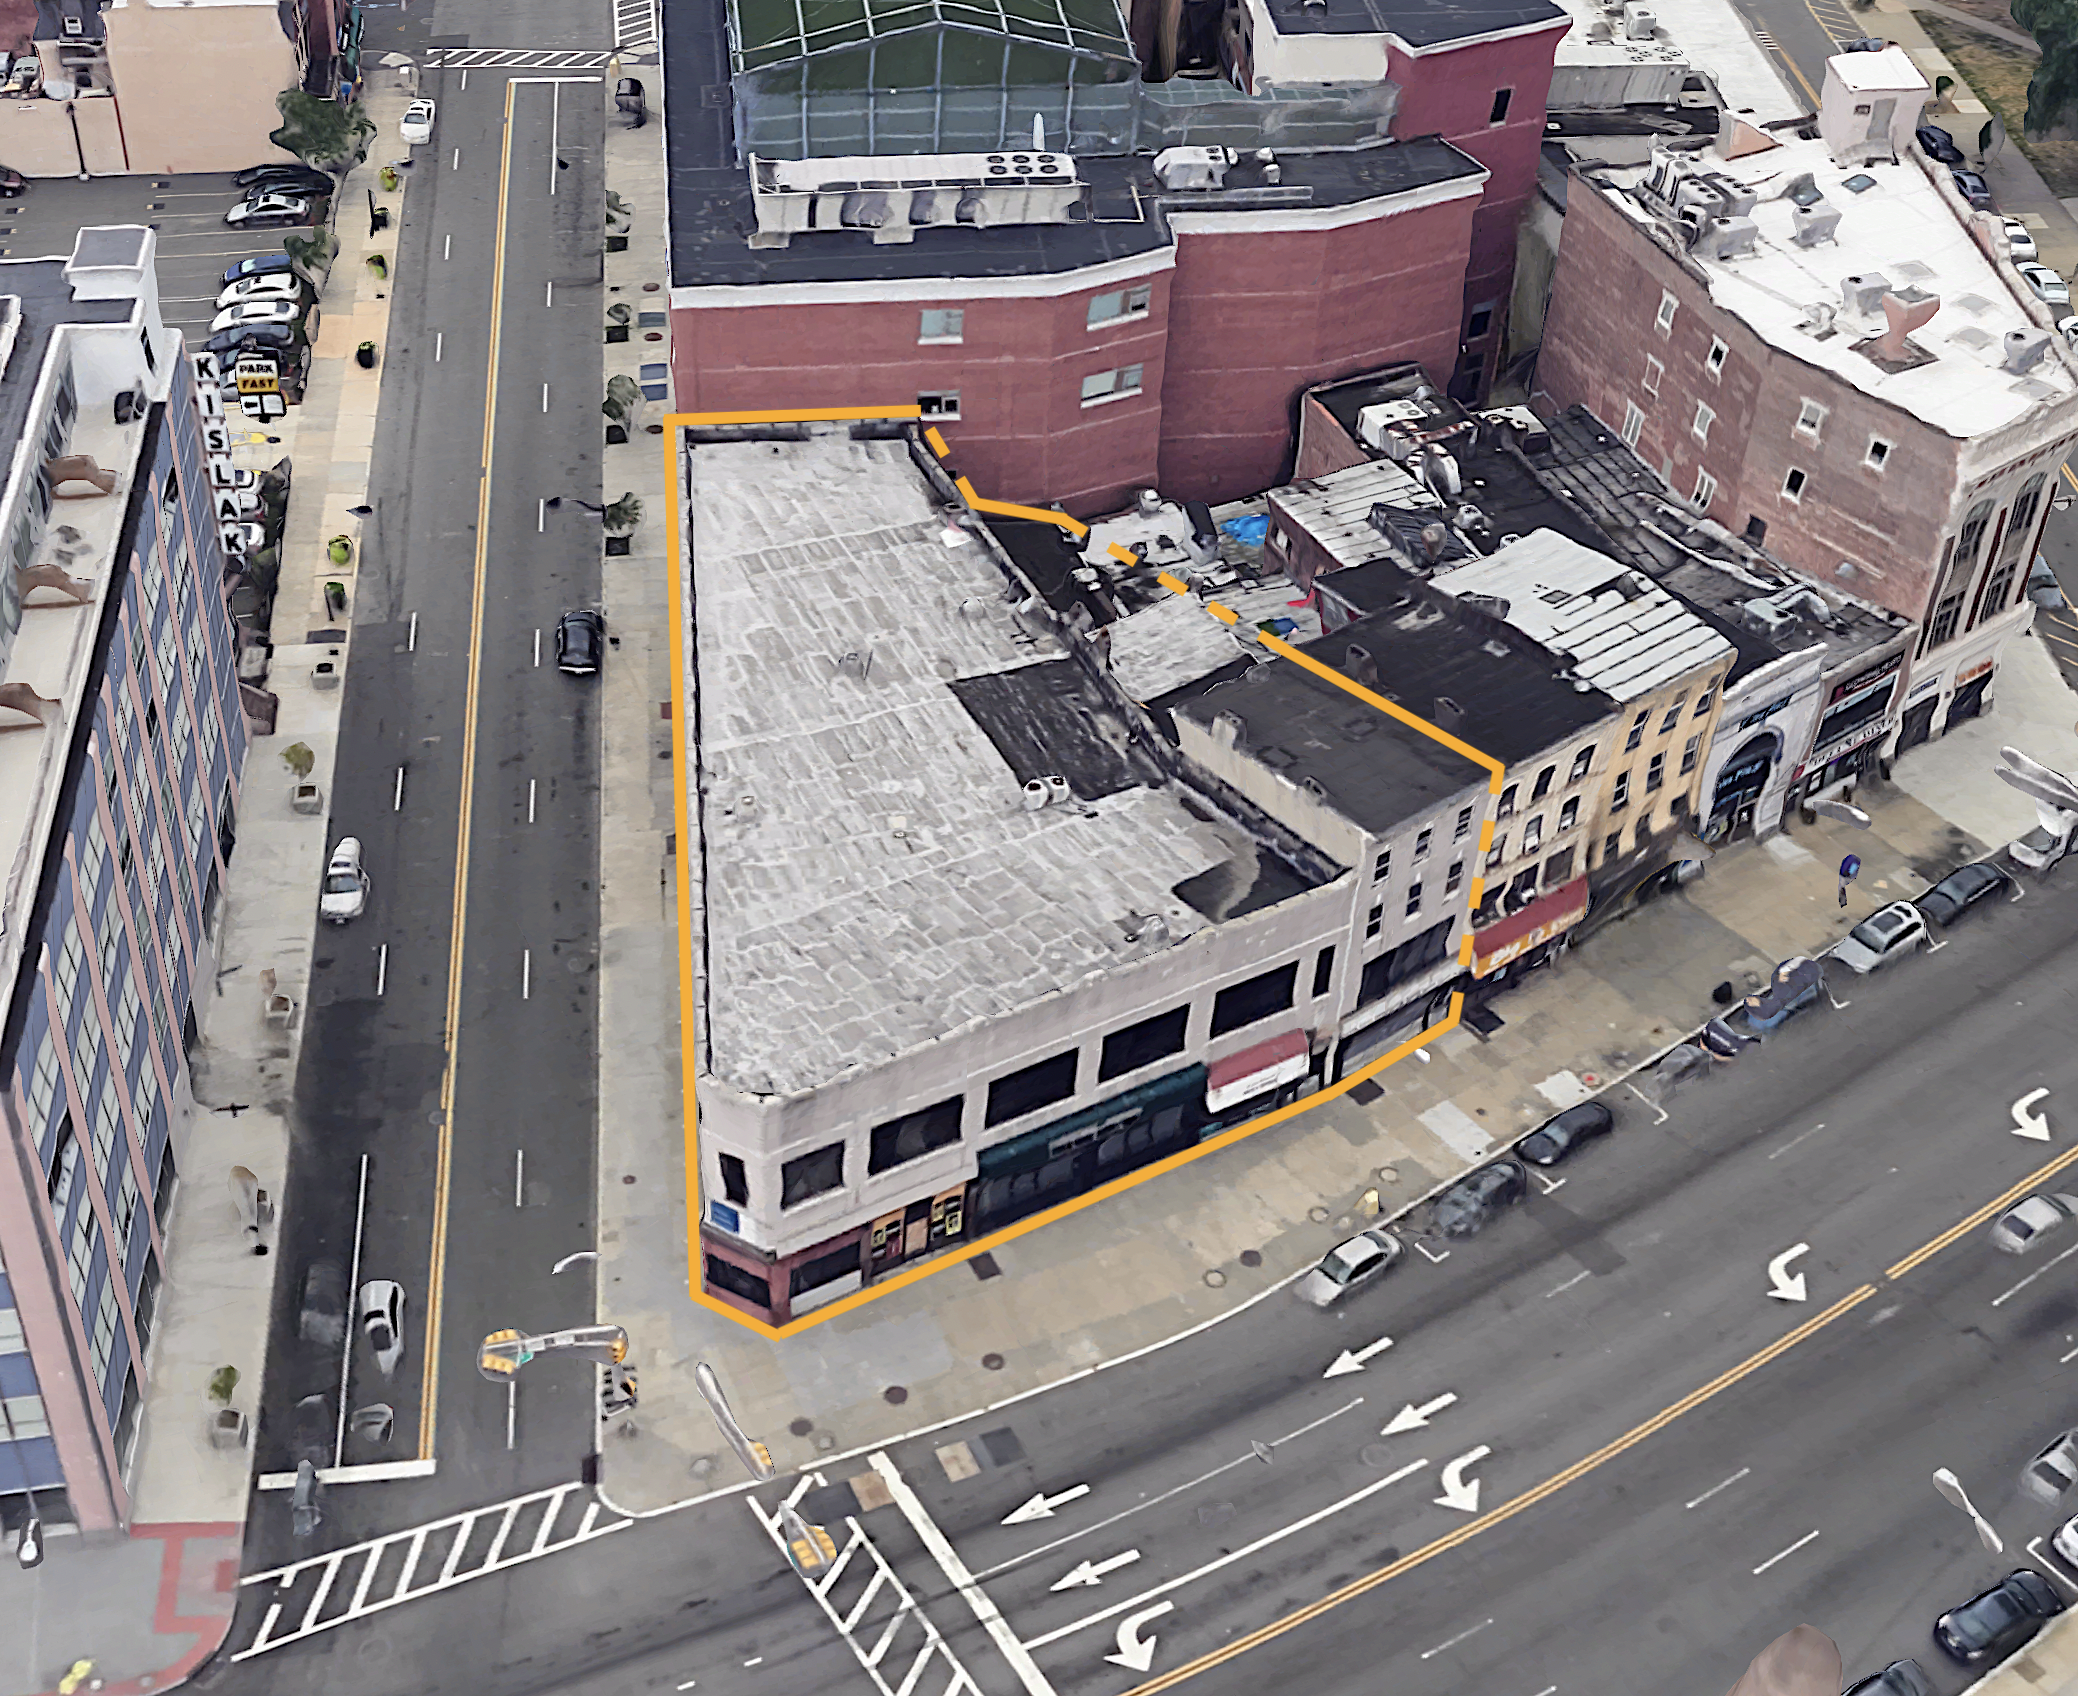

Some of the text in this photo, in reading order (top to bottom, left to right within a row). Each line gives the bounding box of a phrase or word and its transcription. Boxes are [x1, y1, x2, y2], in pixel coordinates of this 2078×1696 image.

[239, 363, 274, 374] PARK
[242, 378, 274, 389] FAST
[197, 357, 241, 551] KISLAK
